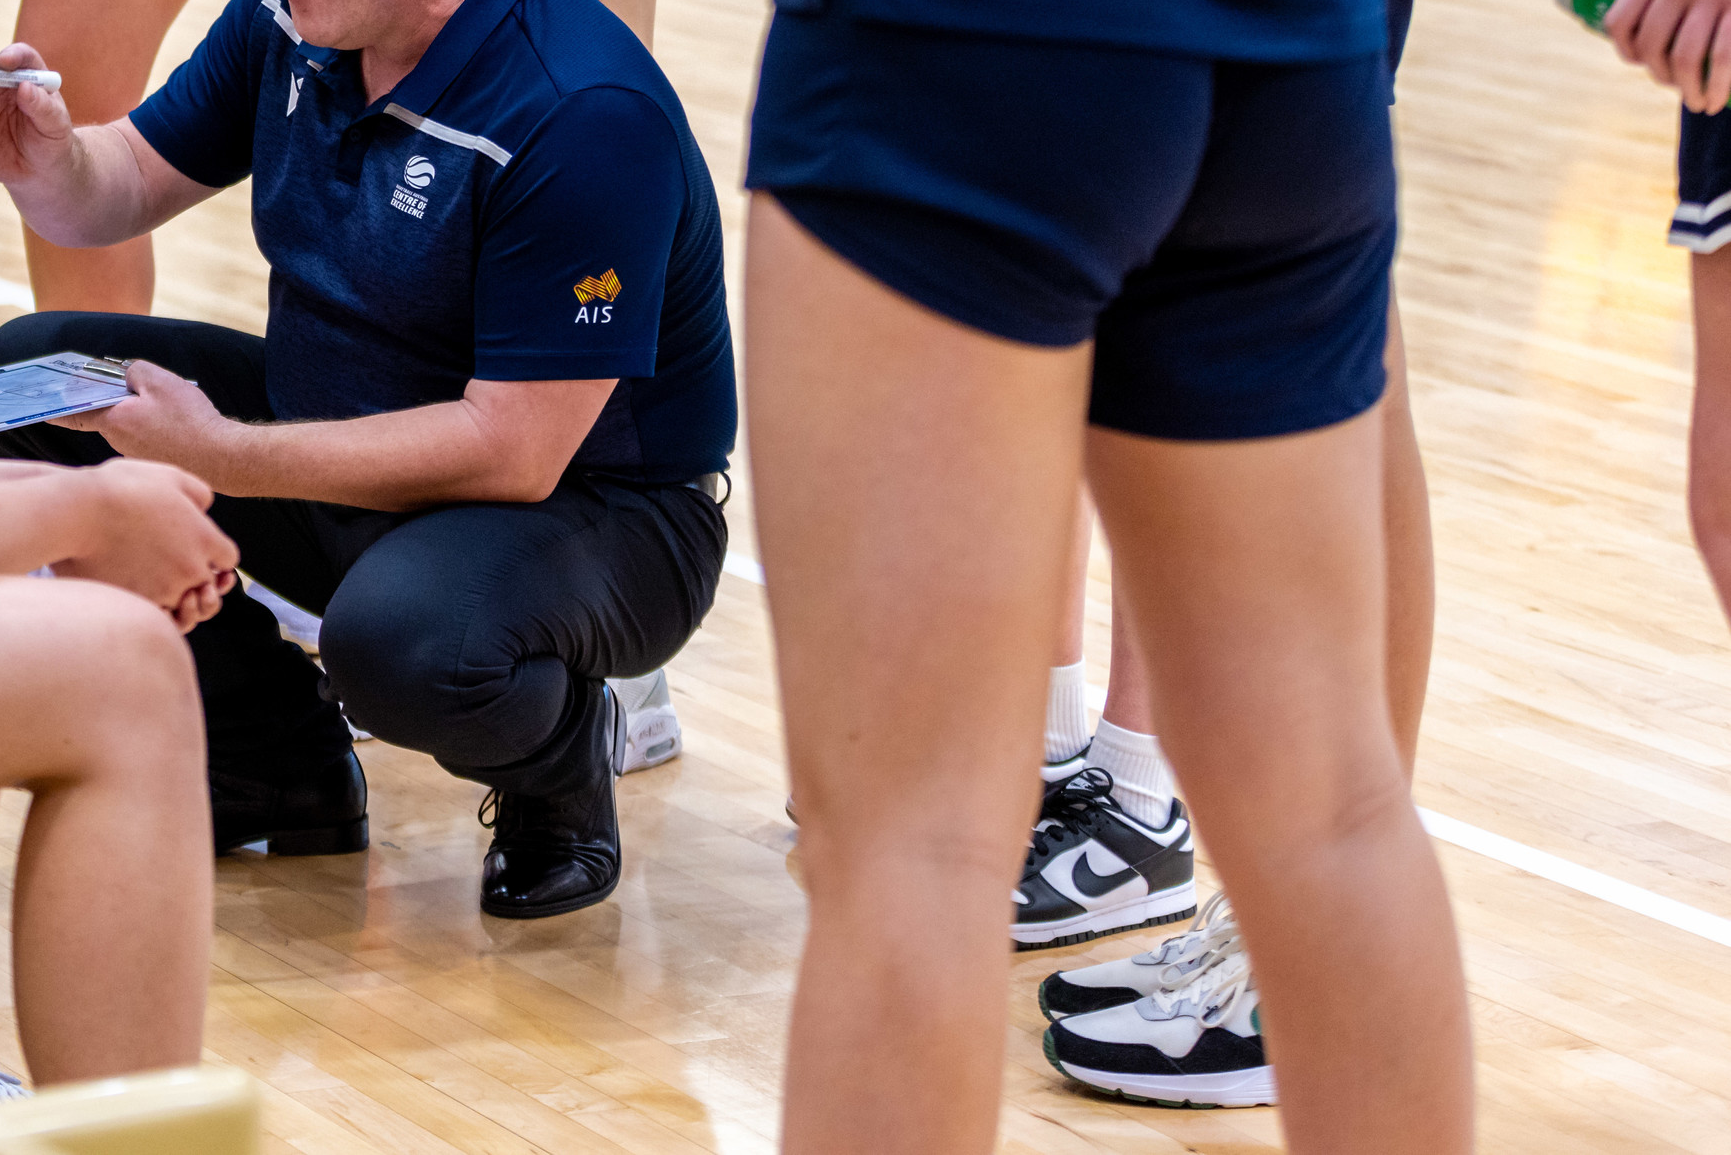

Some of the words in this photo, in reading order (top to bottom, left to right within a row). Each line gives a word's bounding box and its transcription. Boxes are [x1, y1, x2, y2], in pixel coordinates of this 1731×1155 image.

[390, 197, 425, 219] EXCELLENCE
[393, 189, 418, 207] CENTRE
[417, 201, 427, 211] OF
[574, 306, 613, 324] AIS
